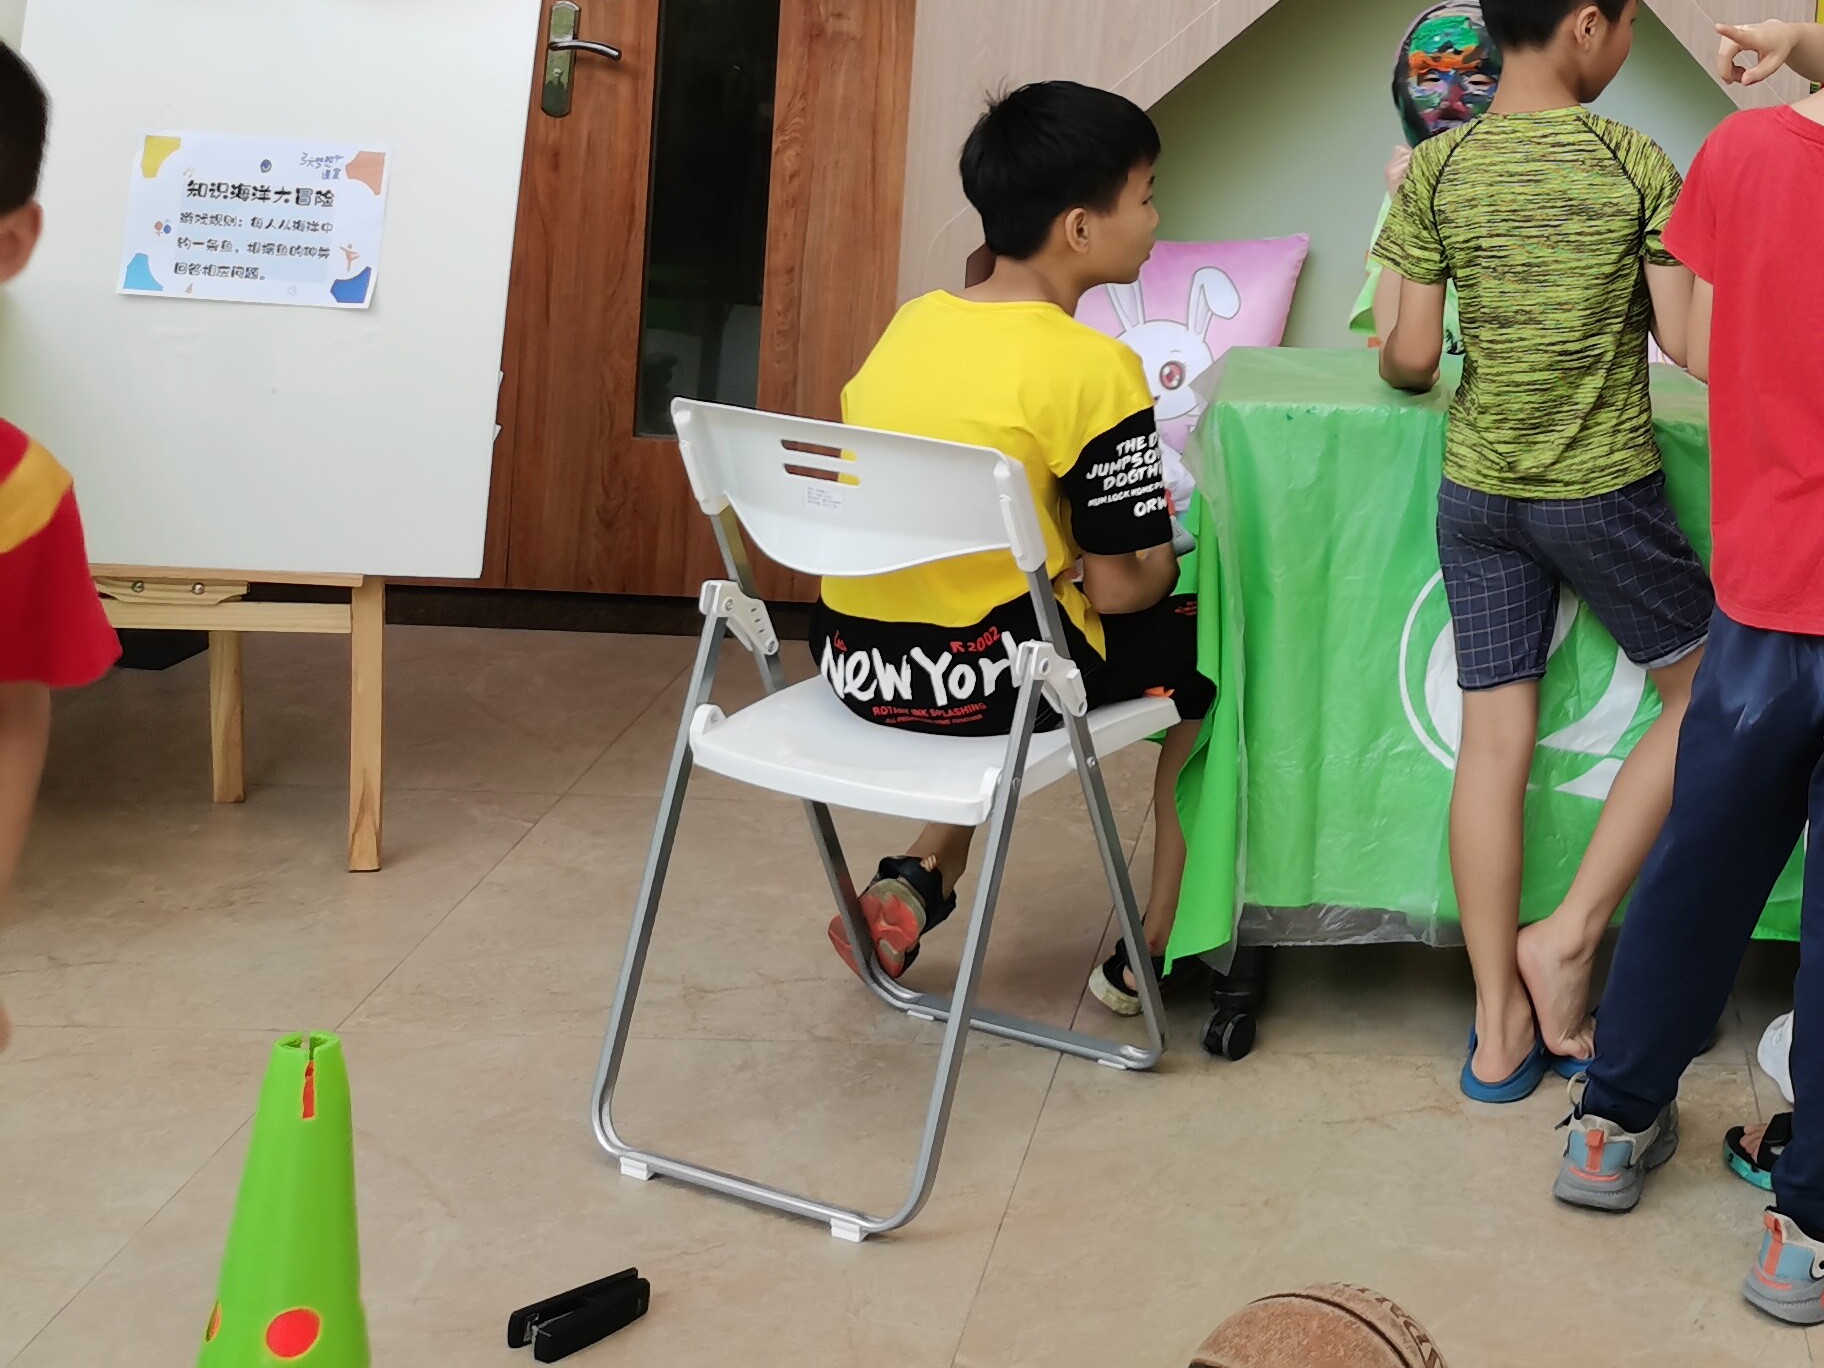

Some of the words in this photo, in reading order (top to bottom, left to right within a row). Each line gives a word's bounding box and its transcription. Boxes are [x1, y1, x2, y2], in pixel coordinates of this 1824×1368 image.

[186, 179, 335, 208] 知识海洋大冒险
[1115, 435, 1148, 457] THE
[966, 625, 1002, 652] 2002
